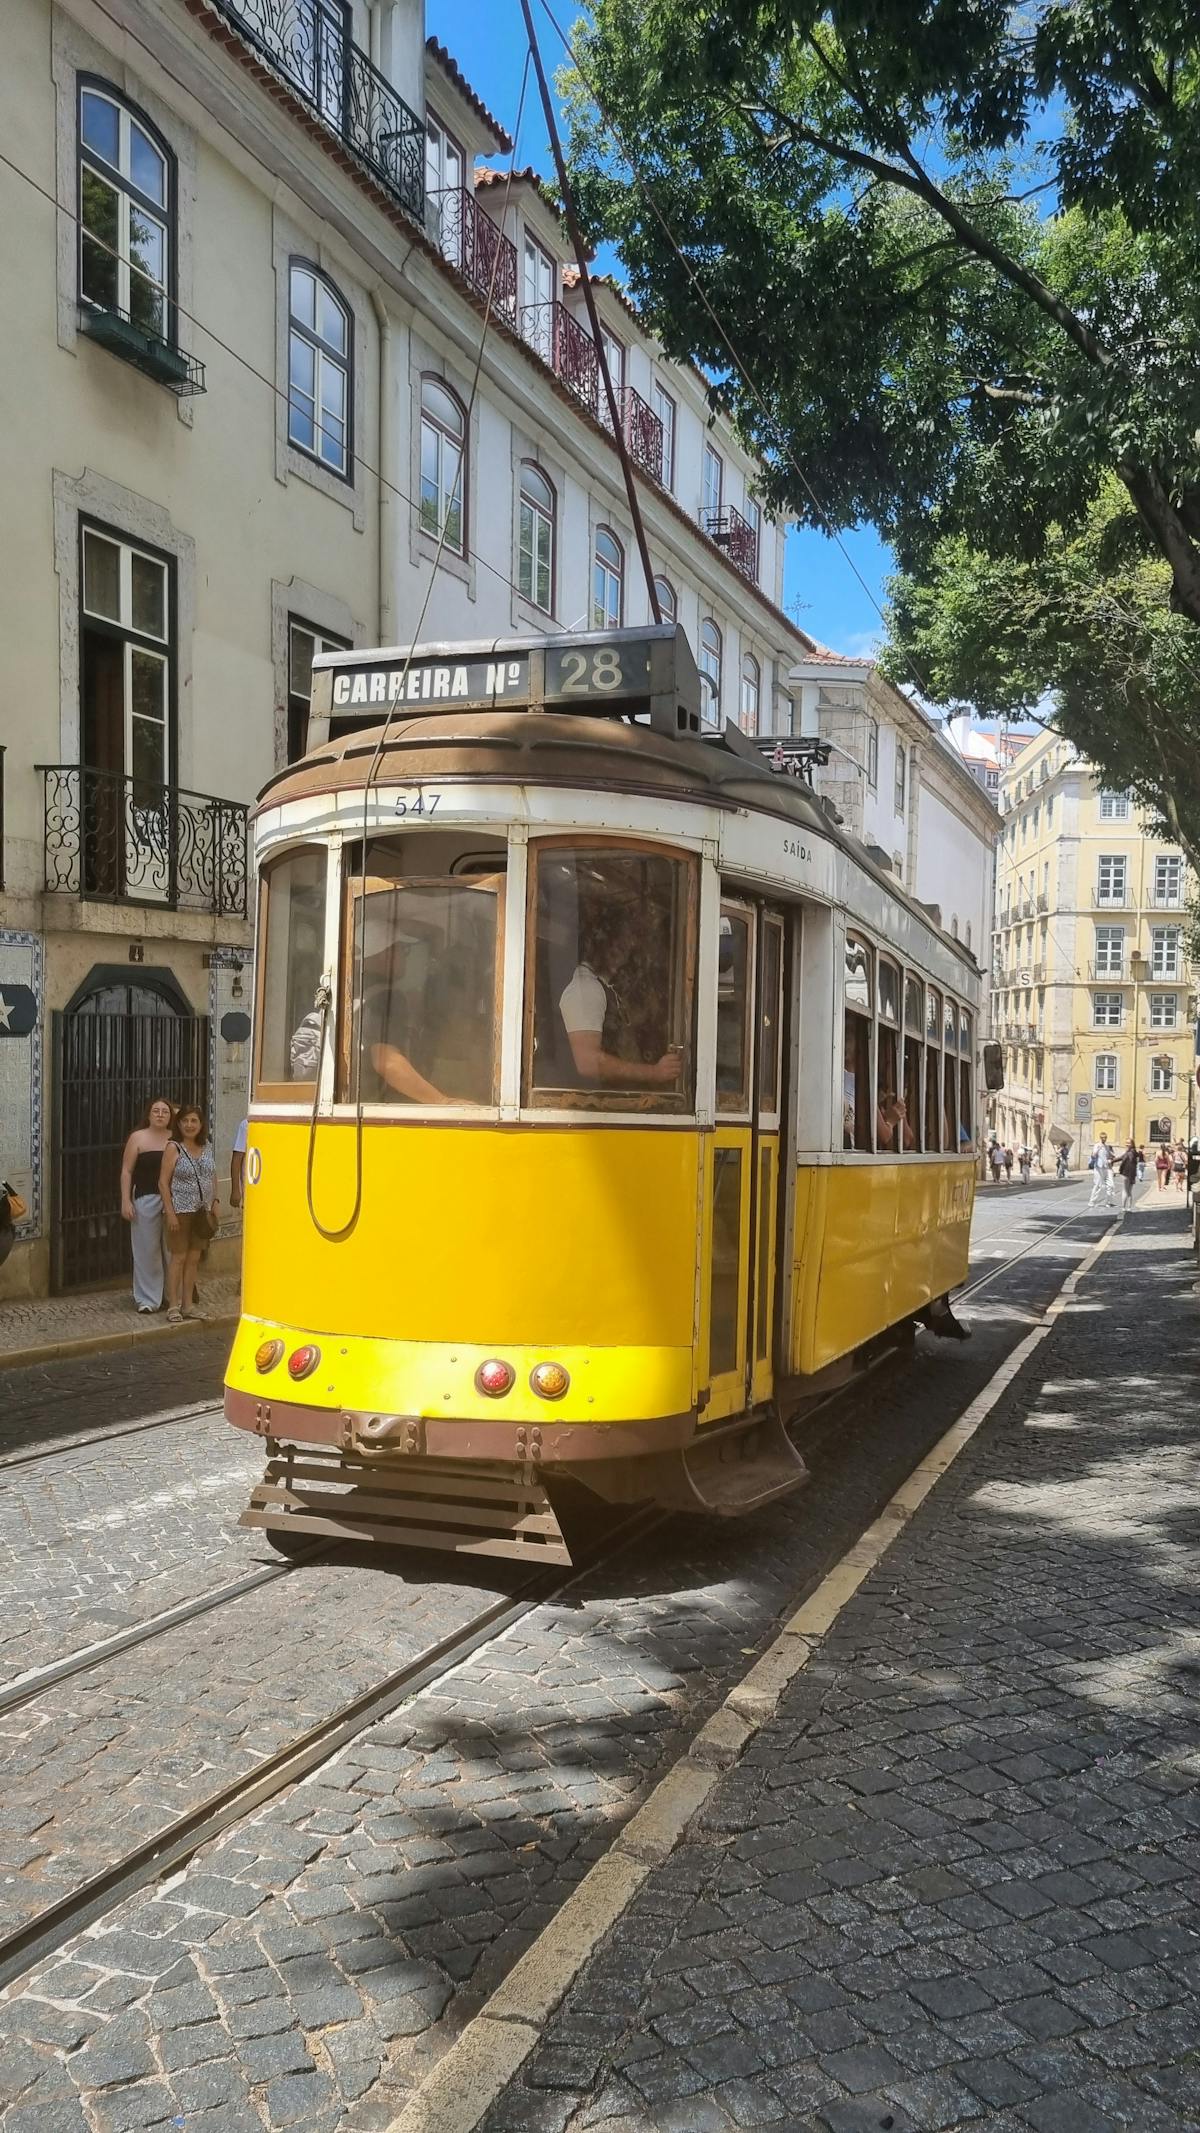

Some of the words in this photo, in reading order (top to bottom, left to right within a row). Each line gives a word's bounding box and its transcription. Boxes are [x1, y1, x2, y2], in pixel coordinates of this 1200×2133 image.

[333, 666, 470, 705] CARREIRA
[560, 648, 623, 694] 28
[395, 794, 441, 816] 547
